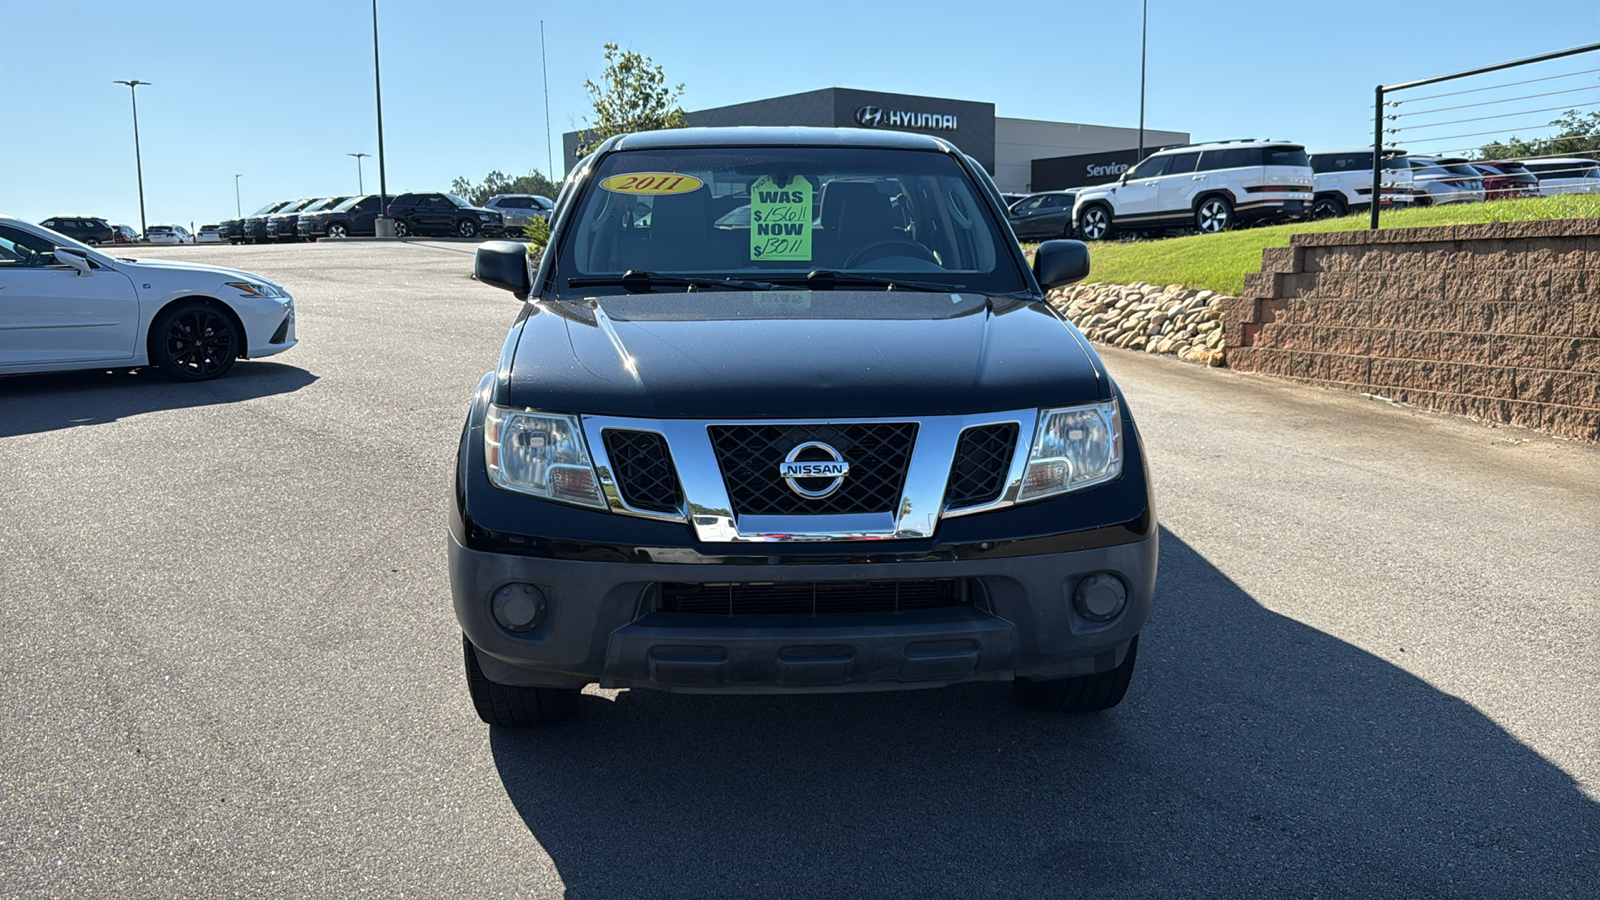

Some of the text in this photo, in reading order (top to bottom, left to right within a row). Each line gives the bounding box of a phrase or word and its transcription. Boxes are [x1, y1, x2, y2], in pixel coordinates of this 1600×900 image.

[890, 110, 958, 130] HYUNDAI
[1086, 162, 1128, 177] Service
[616, 176, 686, 191] 2011
[758, 191, 804, 204] WAS
[757, 223, 804, 236] NOW
[787, 465, 843, 474] NISSAN
